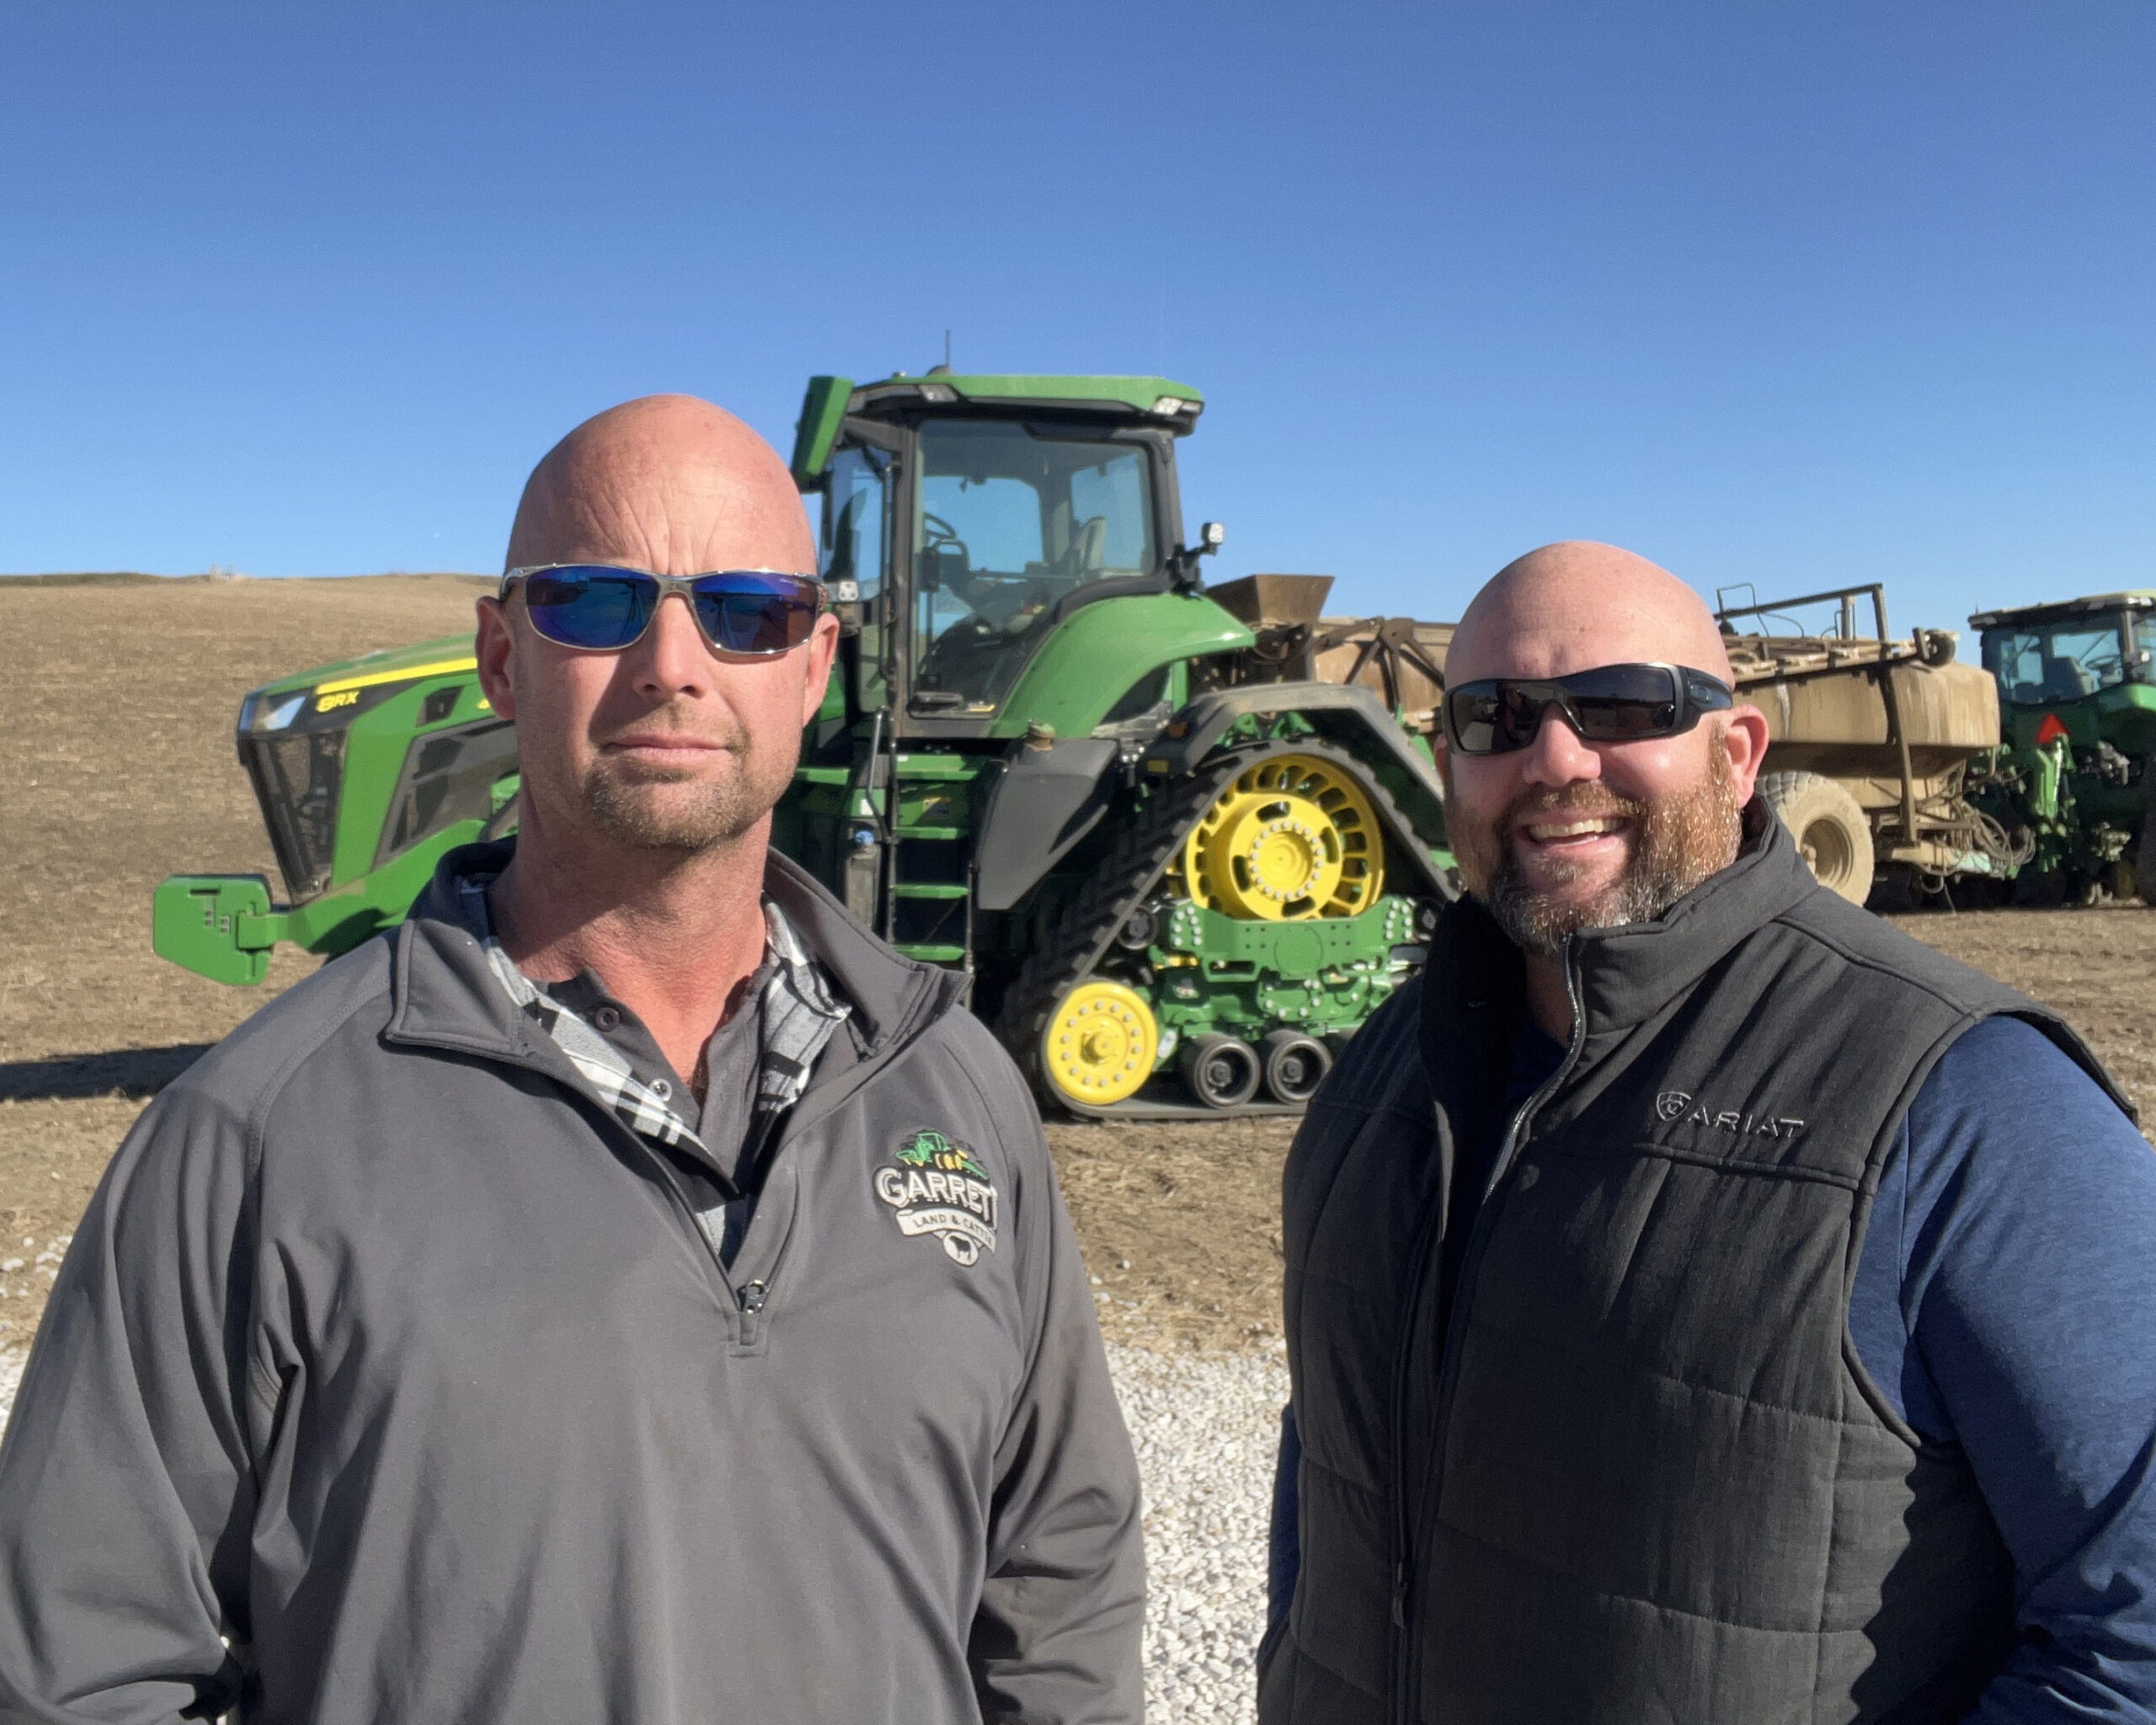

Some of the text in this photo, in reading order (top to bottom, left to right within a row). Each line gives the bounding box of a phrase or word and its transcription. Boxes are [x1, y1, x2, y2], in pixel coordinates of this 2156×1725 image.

[316, 691, 360, 713] 8RX
[1687, 1106, 1804, 1137] ARIAT
[913, 1215, 947, 1227] LAND
[951, 1215, 961, 1226] &
